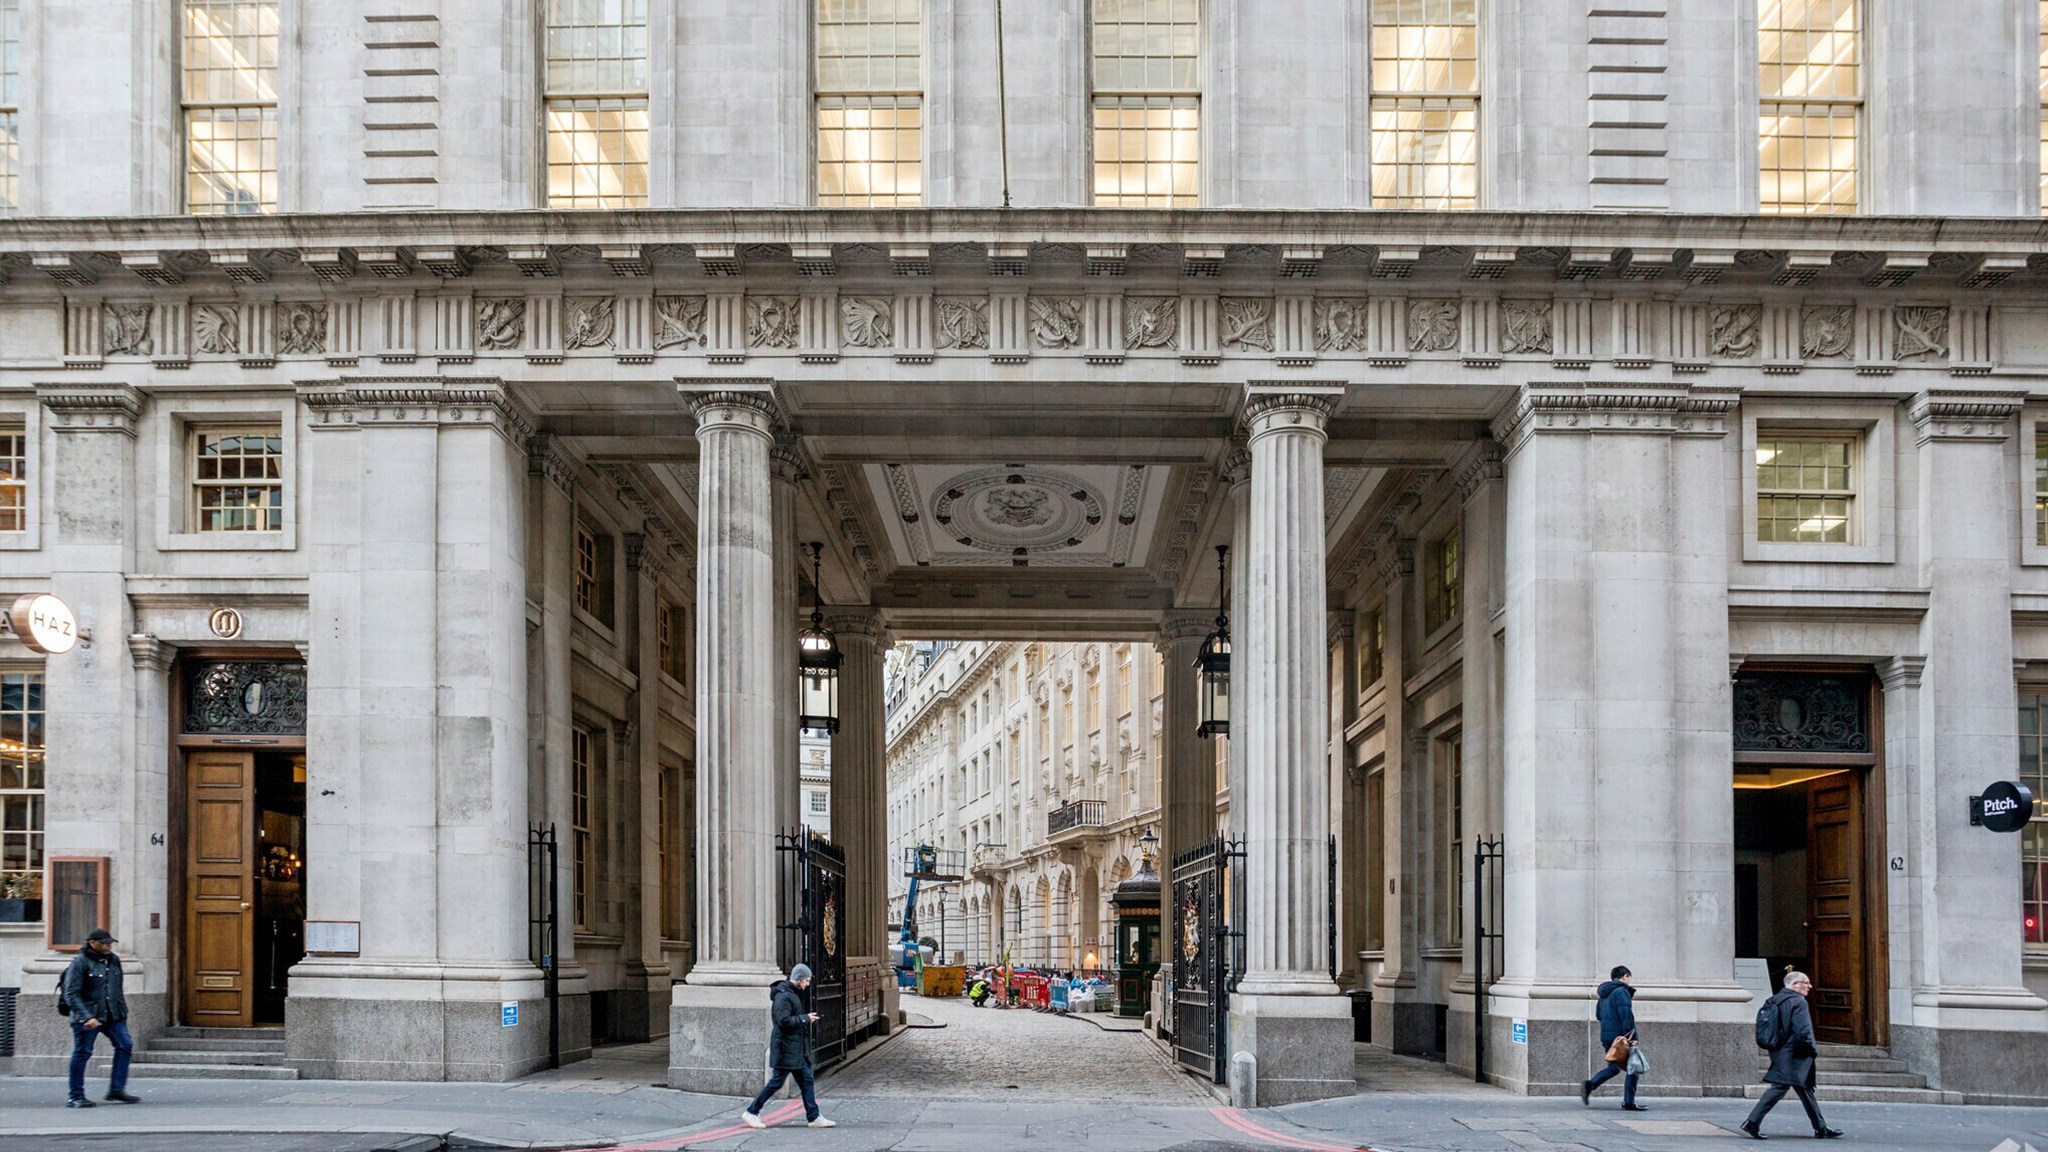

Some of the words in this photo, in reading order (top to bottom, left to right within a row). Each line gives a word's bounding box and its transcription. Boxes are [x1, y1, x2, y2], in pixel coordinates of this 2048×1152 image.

[34, 611, 71, 636] HAZ
[151, 833, 164, 846] 64
[1891, 856, 1904, 871] 62
